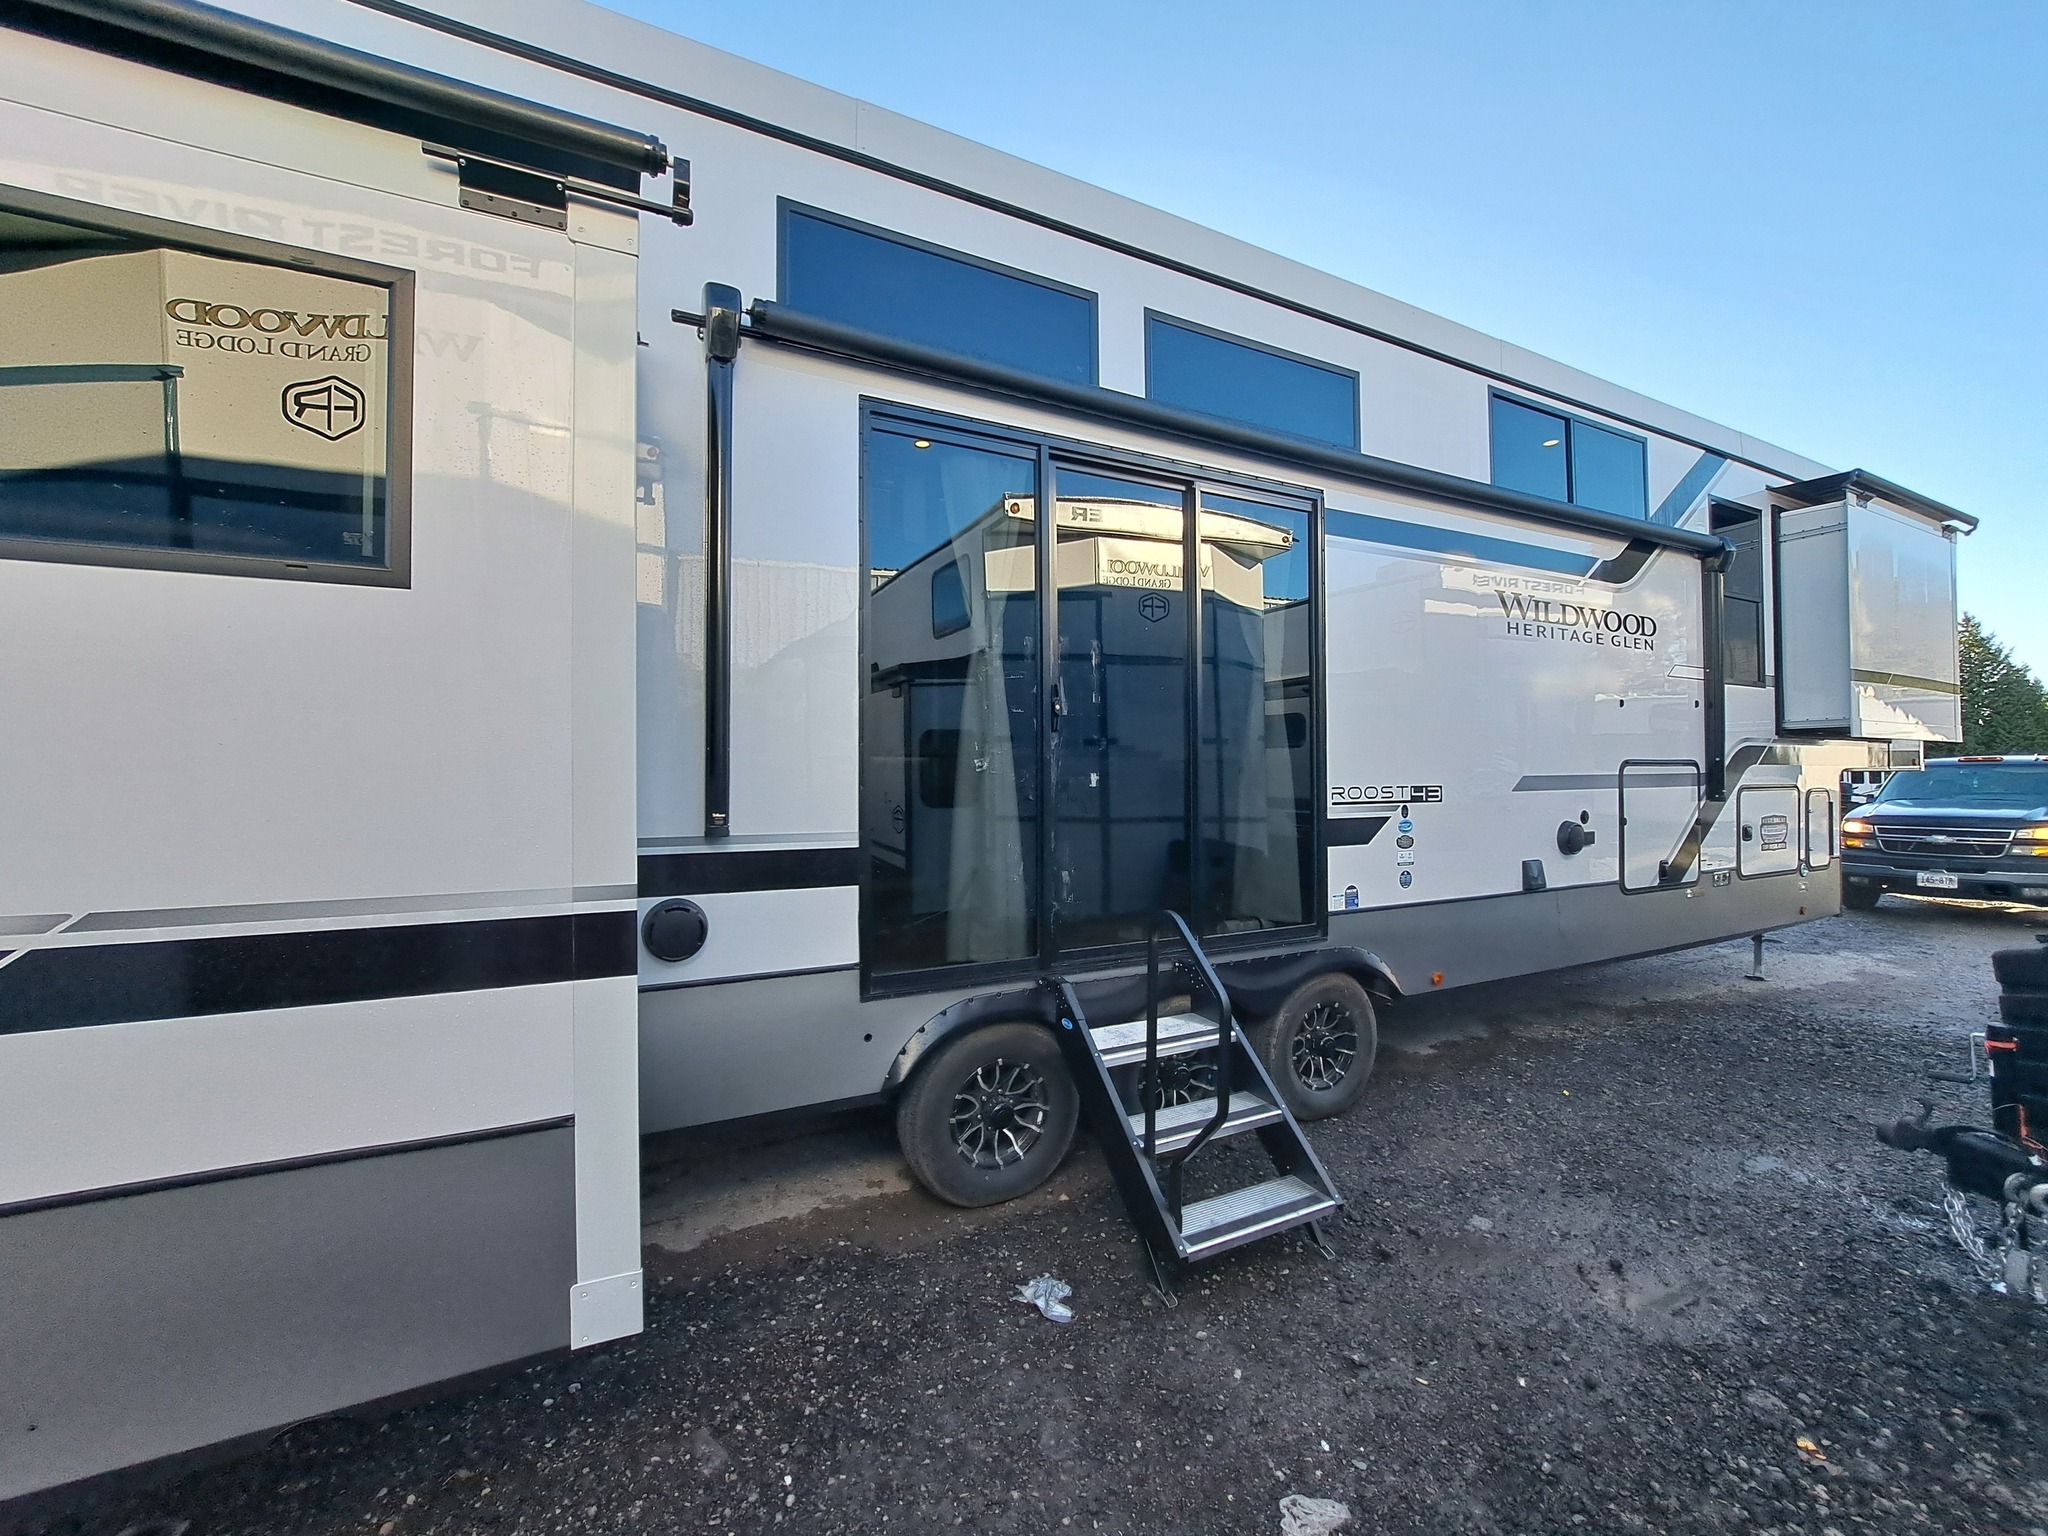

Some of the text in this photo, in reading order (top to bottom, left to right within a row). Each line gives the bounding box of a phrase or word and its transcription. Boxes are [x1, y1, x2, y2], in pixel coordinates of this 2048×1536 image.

[1494, 589, 1657, 637] WILDWOOD
[1507, 621, 1655, 651] HERITAGE GLEN
